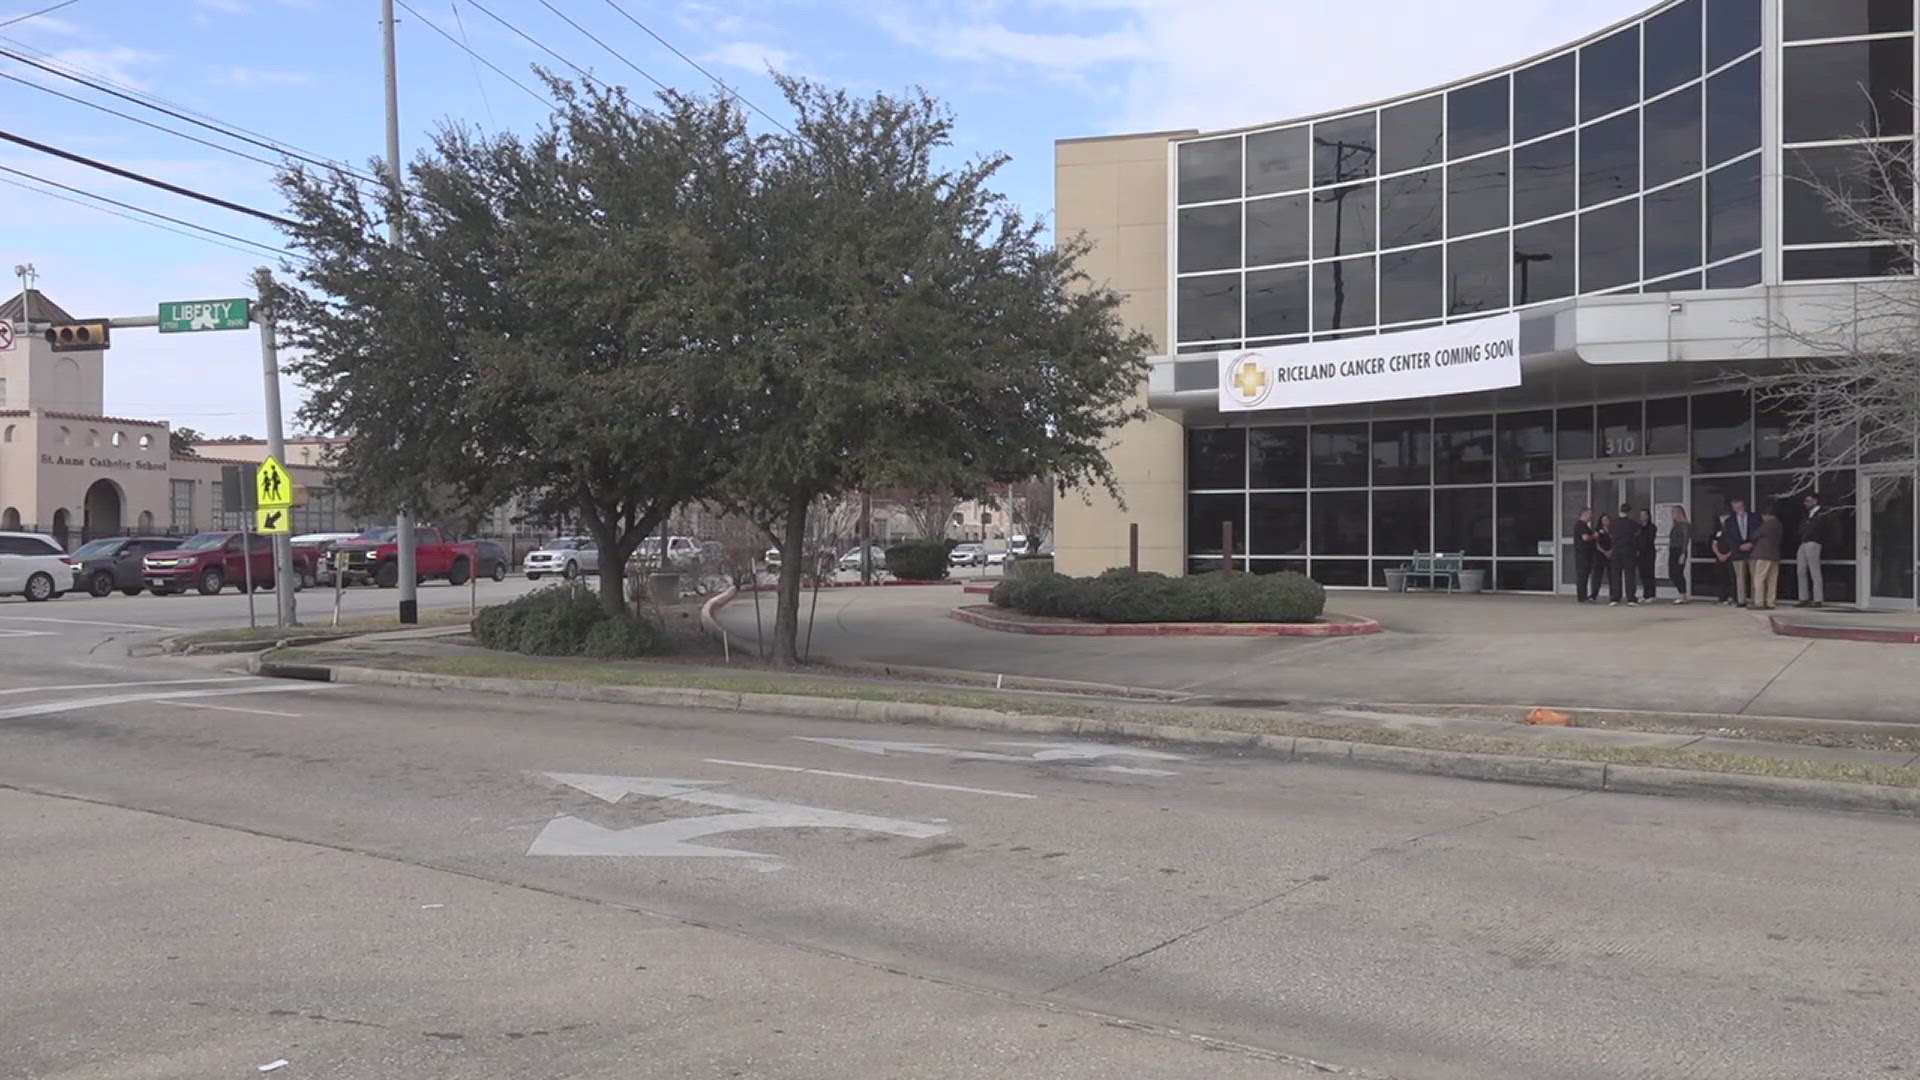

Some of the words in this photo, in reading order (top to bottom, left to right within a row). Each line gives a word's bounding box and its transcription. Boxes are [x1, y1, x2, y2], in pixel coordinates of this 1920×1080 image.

[172, 303, 232, 321] LIBERTY
[1278, 363, 1336, 383] RICELAND
[1340, 357, 1385, 377] CANCER
[1389, 351, 1431, 372] CENTER
[1435, 345, 1481, 367] COMING
[1485, 338, 1514, 361] SOON
[1605, 437, 1635, 454] 310
[41, 453, 54, 465] St.
[57, 455, 84, 466] Anne
[90, 457, 131, 469] Catholic
[136, 460, 167, 471] School
